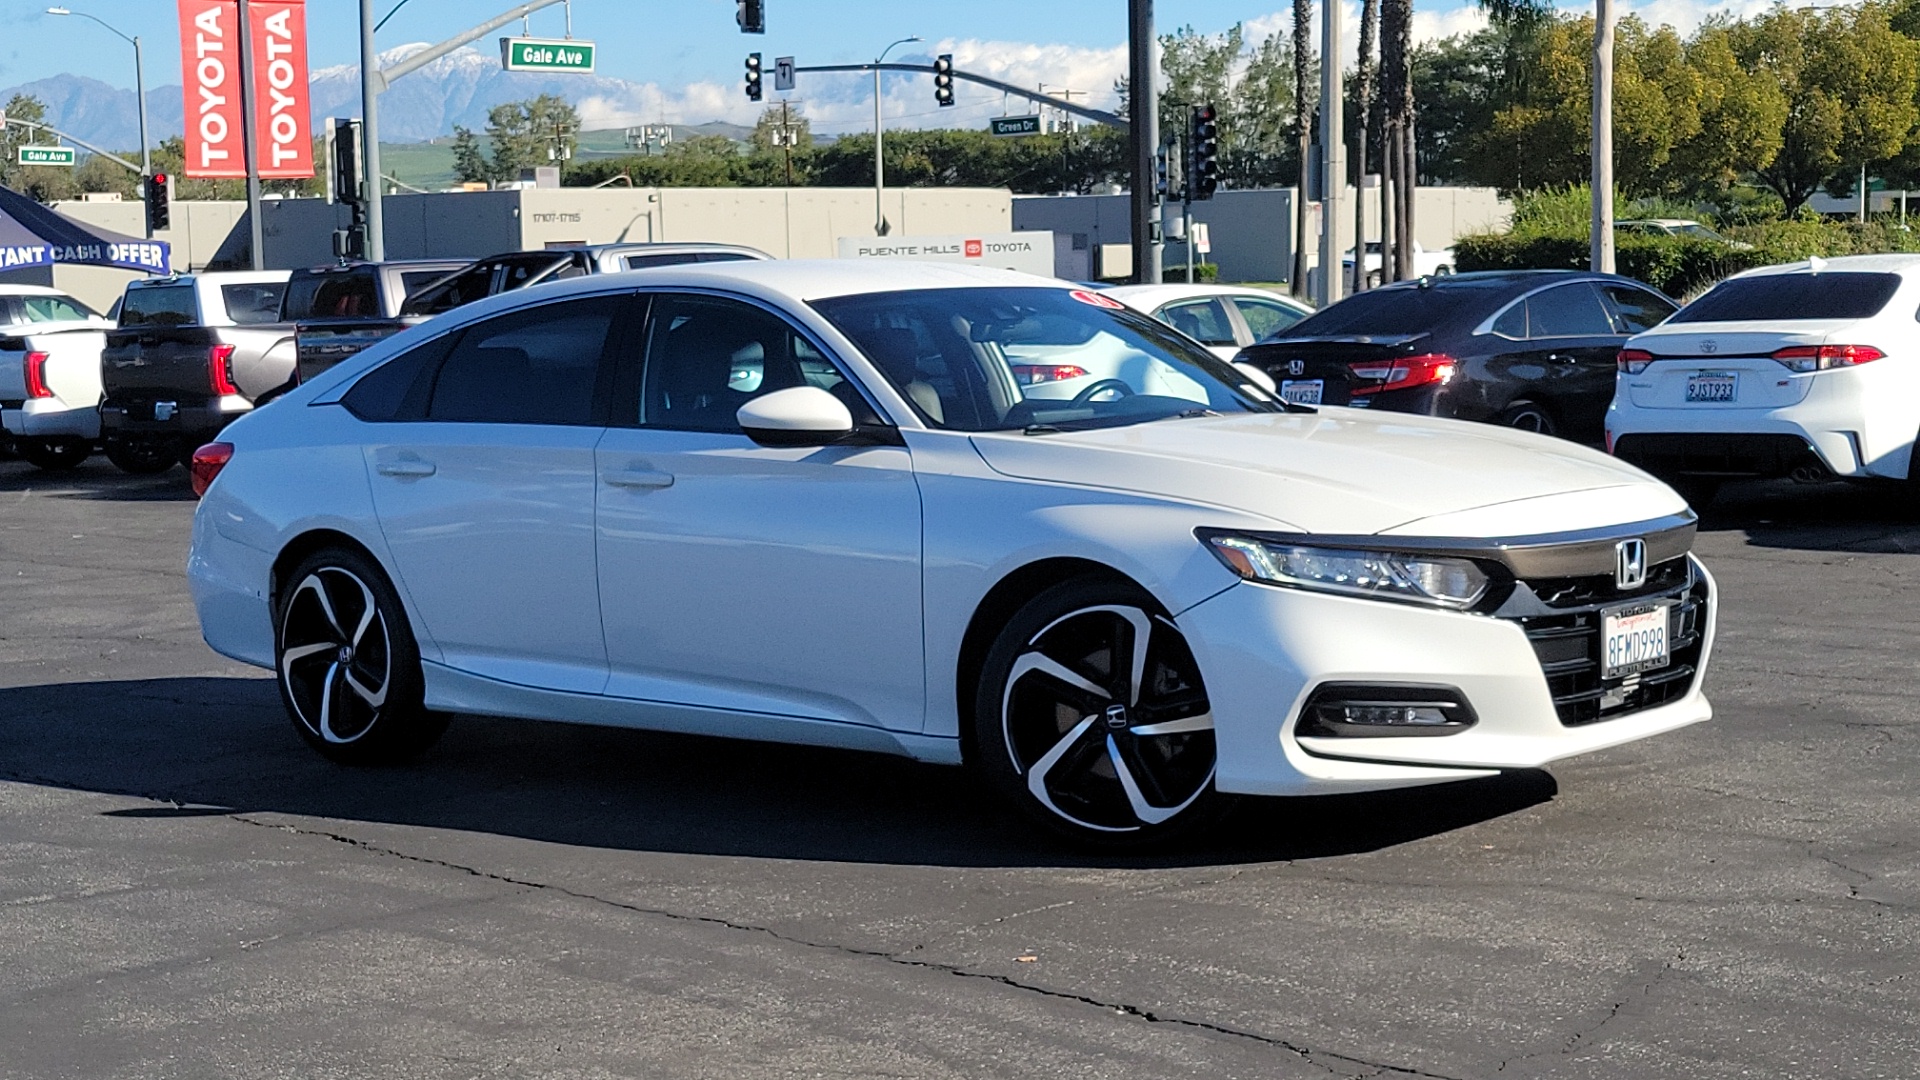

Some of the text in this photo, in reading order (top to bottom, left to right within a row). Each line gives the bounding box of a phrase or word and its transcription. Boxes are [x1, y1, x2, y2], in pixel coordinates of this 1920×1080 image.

[523, 47, 583, 64] Gale Ave
[195, 6, 229, 168] TOYOTA
[265, 8, 298, 168] TOYOTA
[998, 120, 1034, 132] Green Dr
[28, 151, 67, 161] Gale Ave
[0, 243, 164, 268] TANT CASH OFFER
[859, 242, 1032, 256] PUENTE HILLS TOYOTA
[1689, 383, 1733, 397] 9JST933
[1609, 627, 1663, 666] 8FMD998
